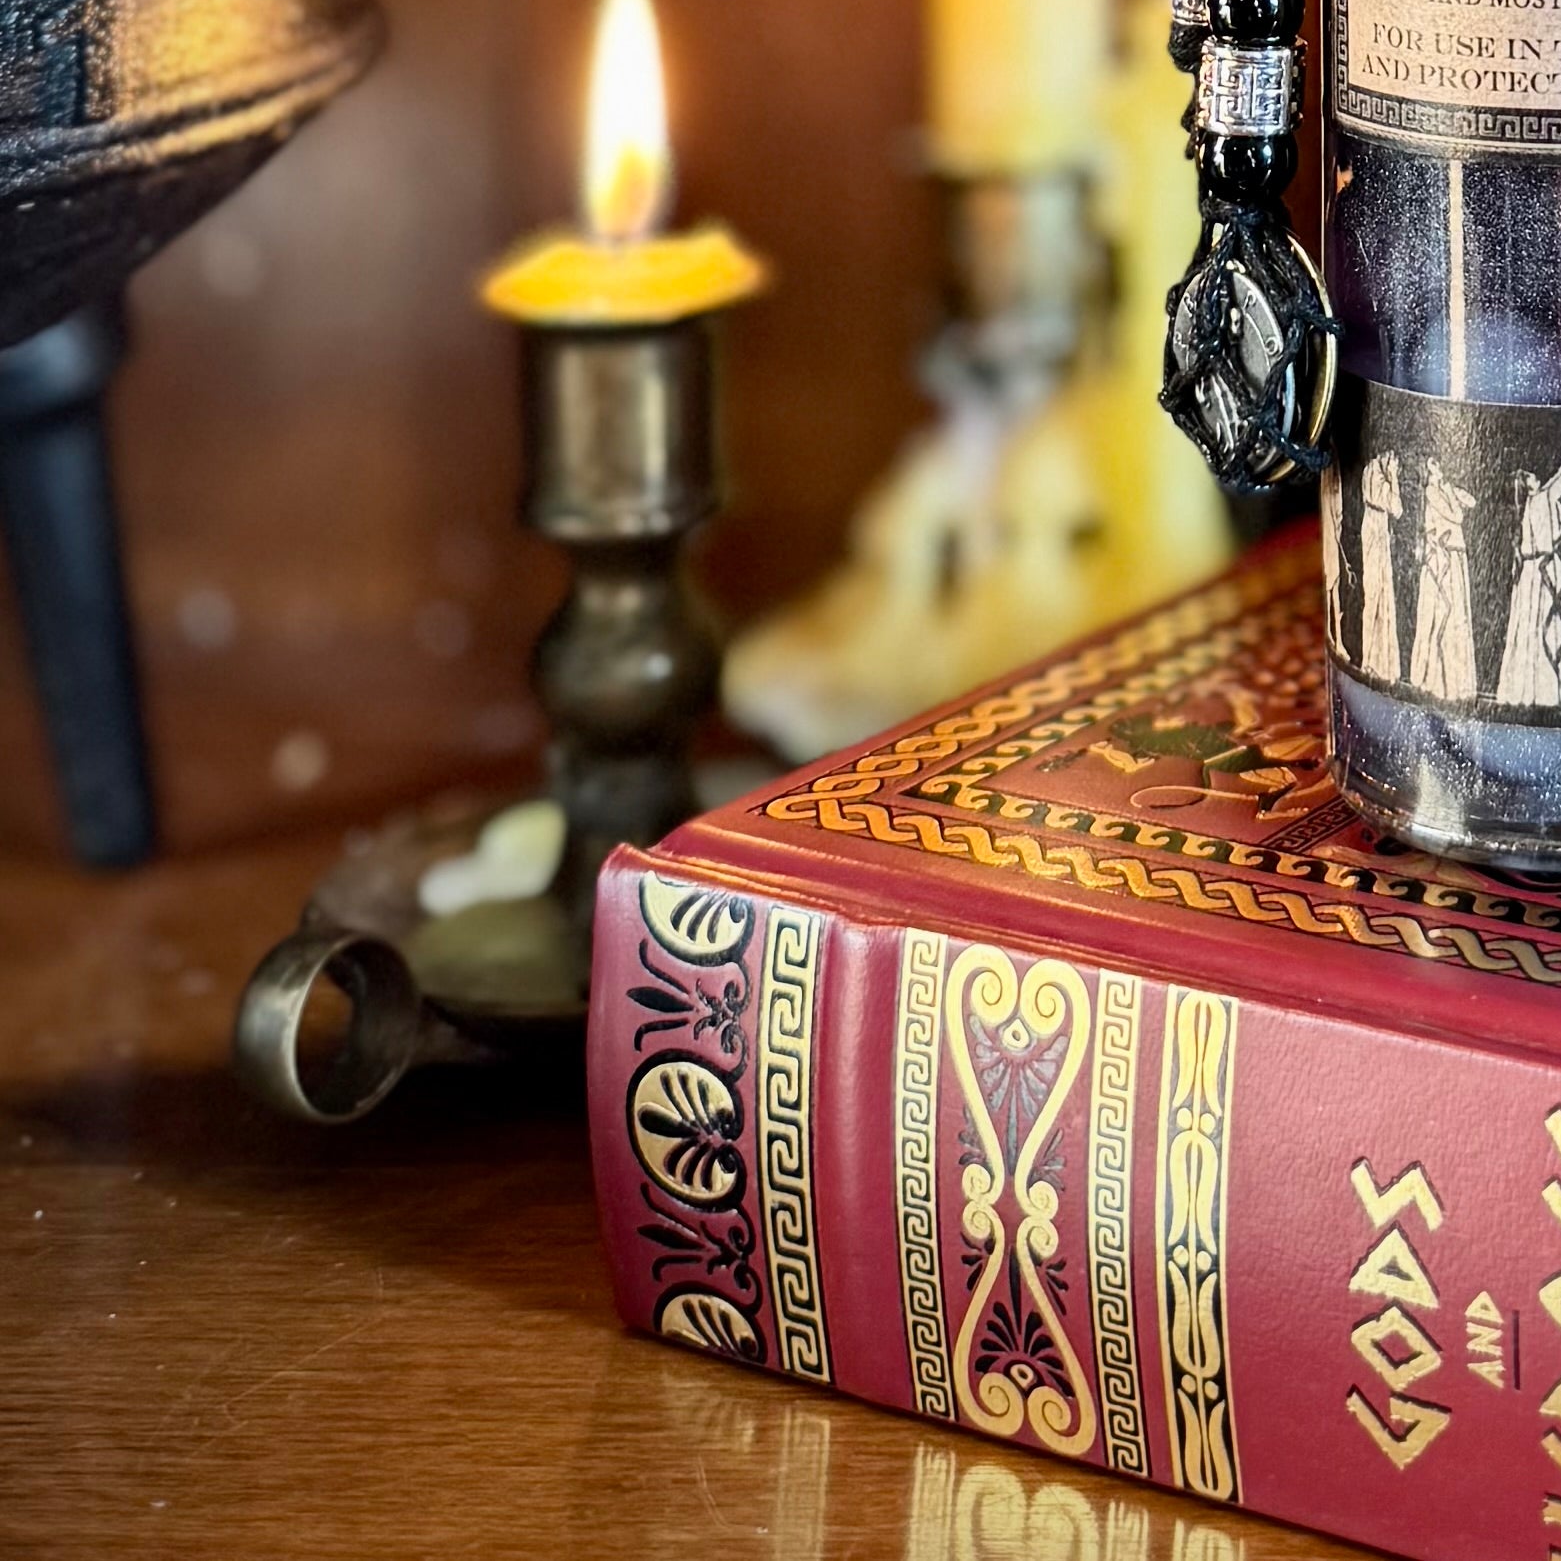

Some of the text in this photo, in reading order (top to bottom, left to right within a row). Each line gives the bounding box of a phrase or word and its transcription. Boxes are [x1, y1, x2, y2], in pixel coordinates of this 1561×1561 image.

[1361, 54, 1410, 82] AND
[1373, 22, 1424, 51] FOR
[1434, 33, 1496, 58] USE
[1507, 38, 1543, 60] IN
[1345, 1156, 1453, 1471] GODS
[1465, 1290, 1506, 1389] AND
